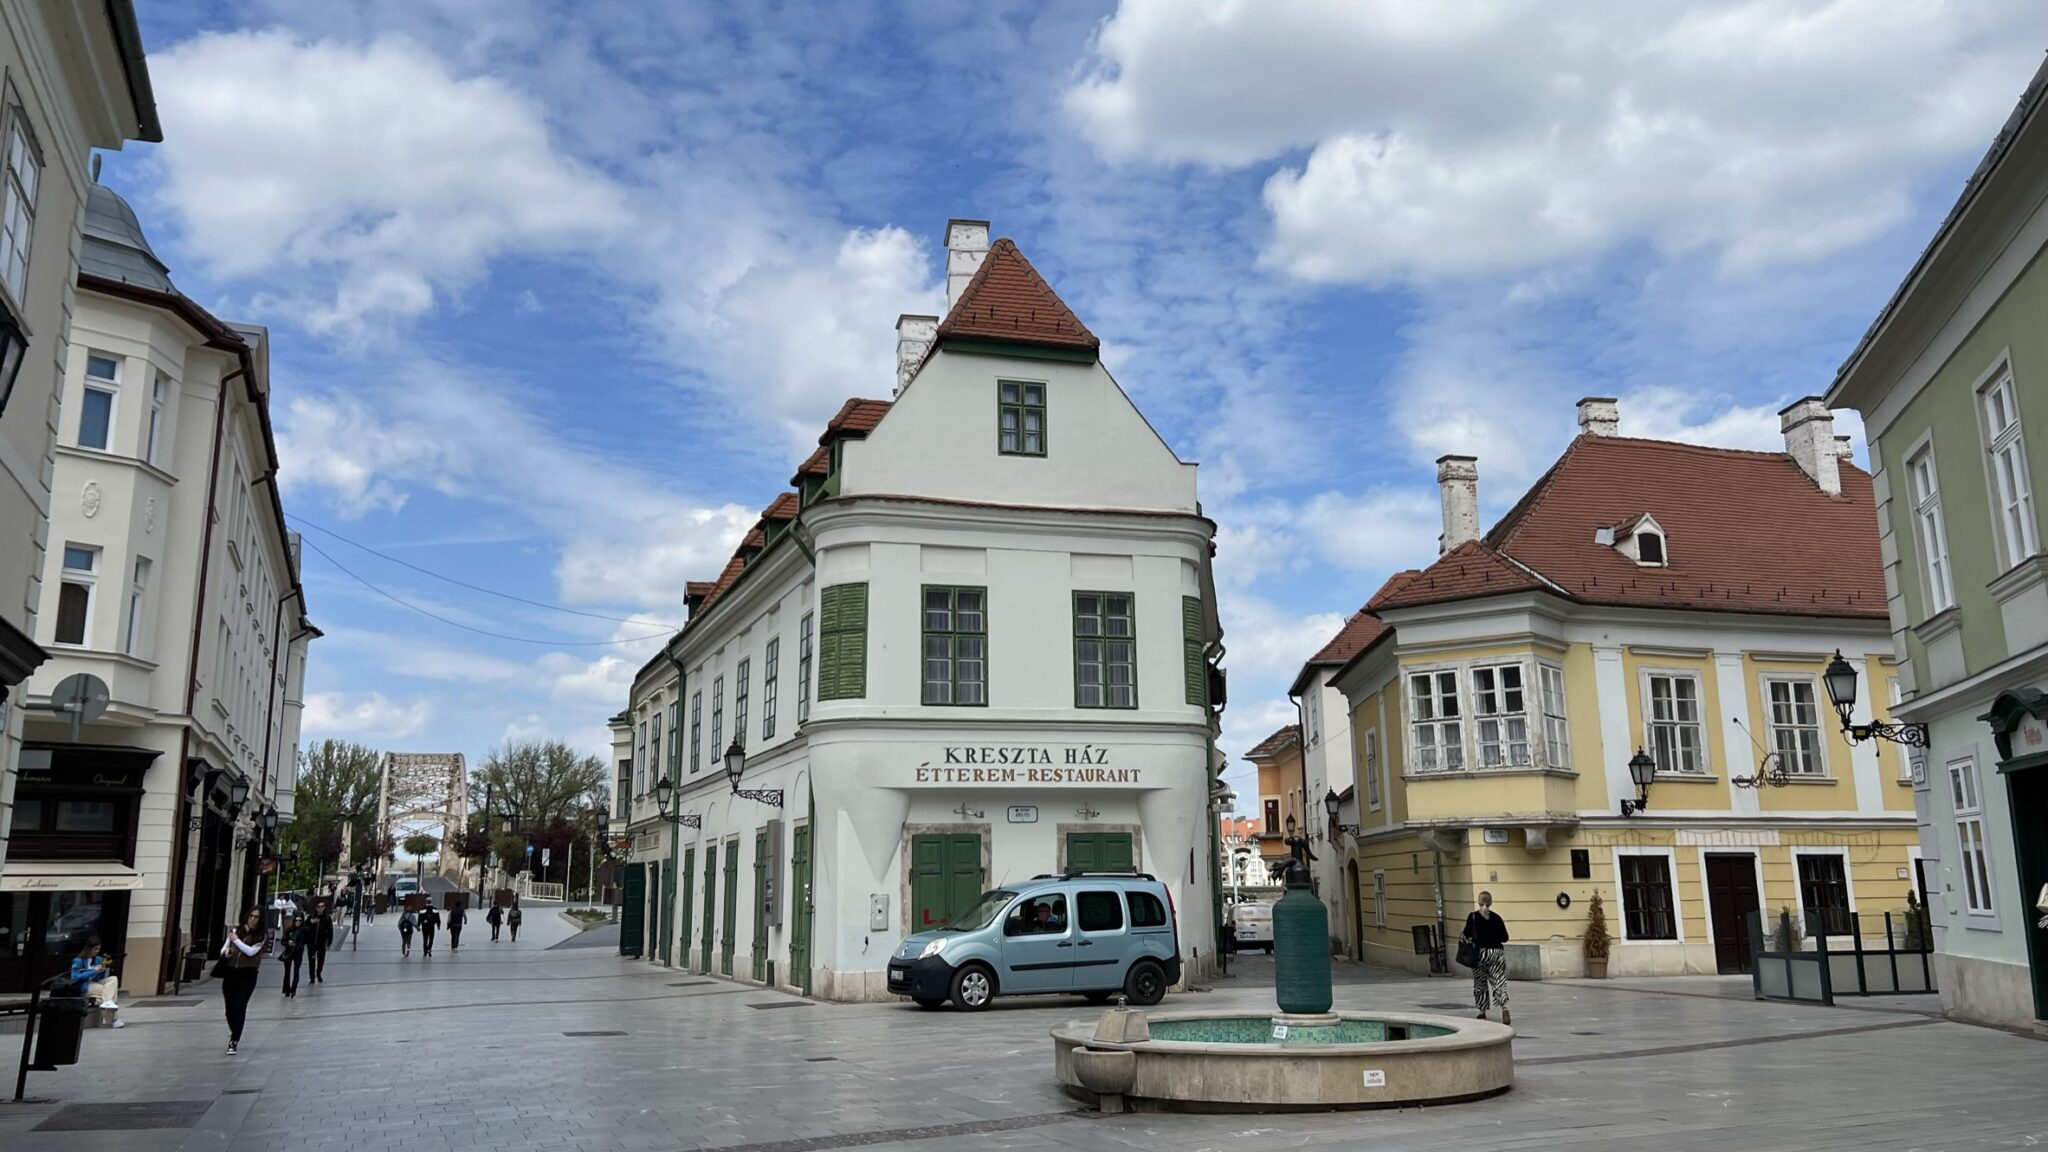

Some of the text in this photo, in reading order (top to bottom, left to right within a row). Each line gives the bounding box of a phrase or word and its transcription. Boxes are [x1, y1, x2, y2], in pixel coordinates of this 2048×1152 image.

[944, 744, 1109, 765] KRESZTA HÁZ
[915, 762, 1141, 783] ÉTTEREM-RESTAURANT
